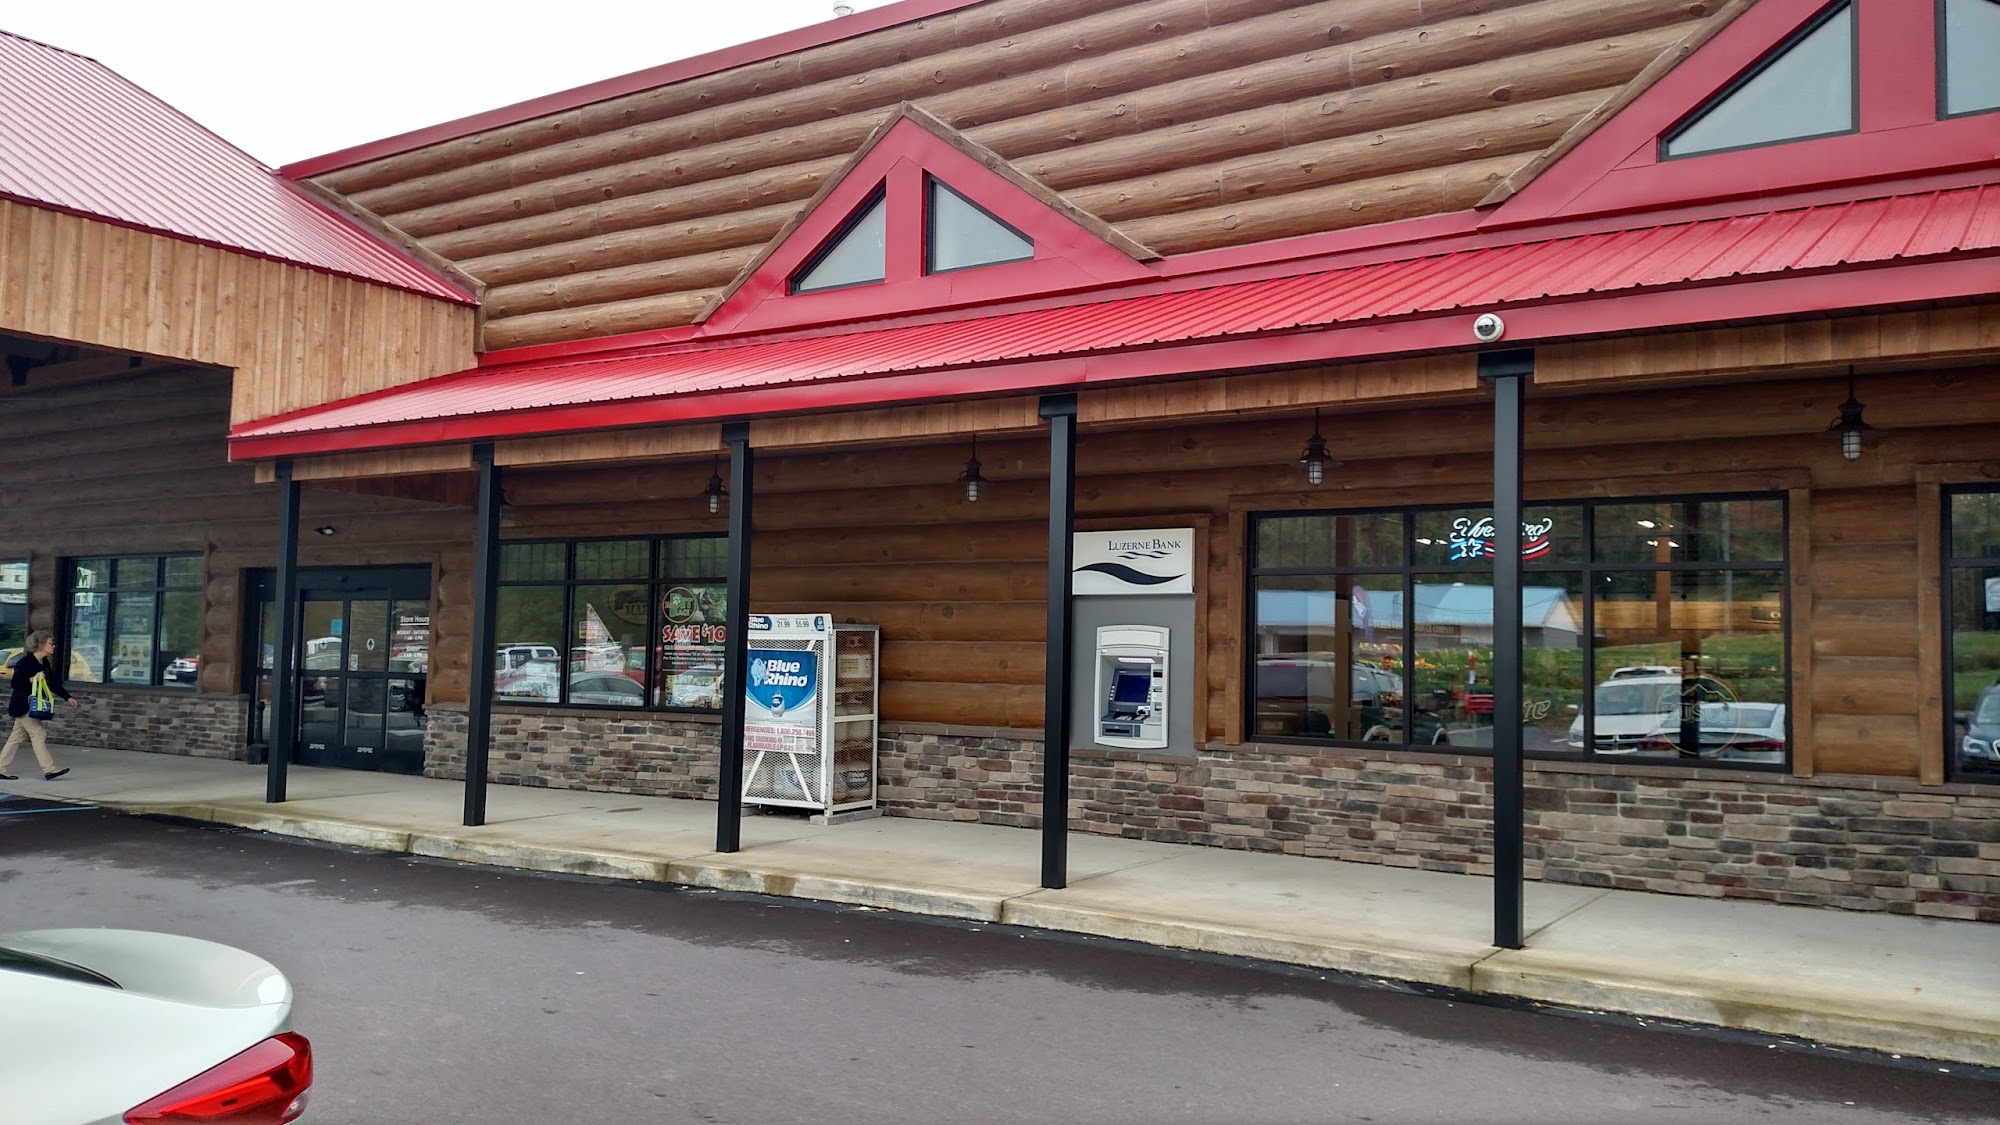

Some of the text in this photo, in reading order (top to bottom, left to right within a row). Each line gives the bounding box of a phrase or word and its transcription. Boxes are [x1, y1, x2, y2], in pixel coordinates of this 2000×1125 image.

[1108, 539, 1182, 551] LUZERNE BANK
[662, 623, 726, 643] SAVE $10
[767, 659, 801, 673] Blue
[764, 672, 808, 687] Rhino
[745, 725, 776, 734] MERGENCIES:
